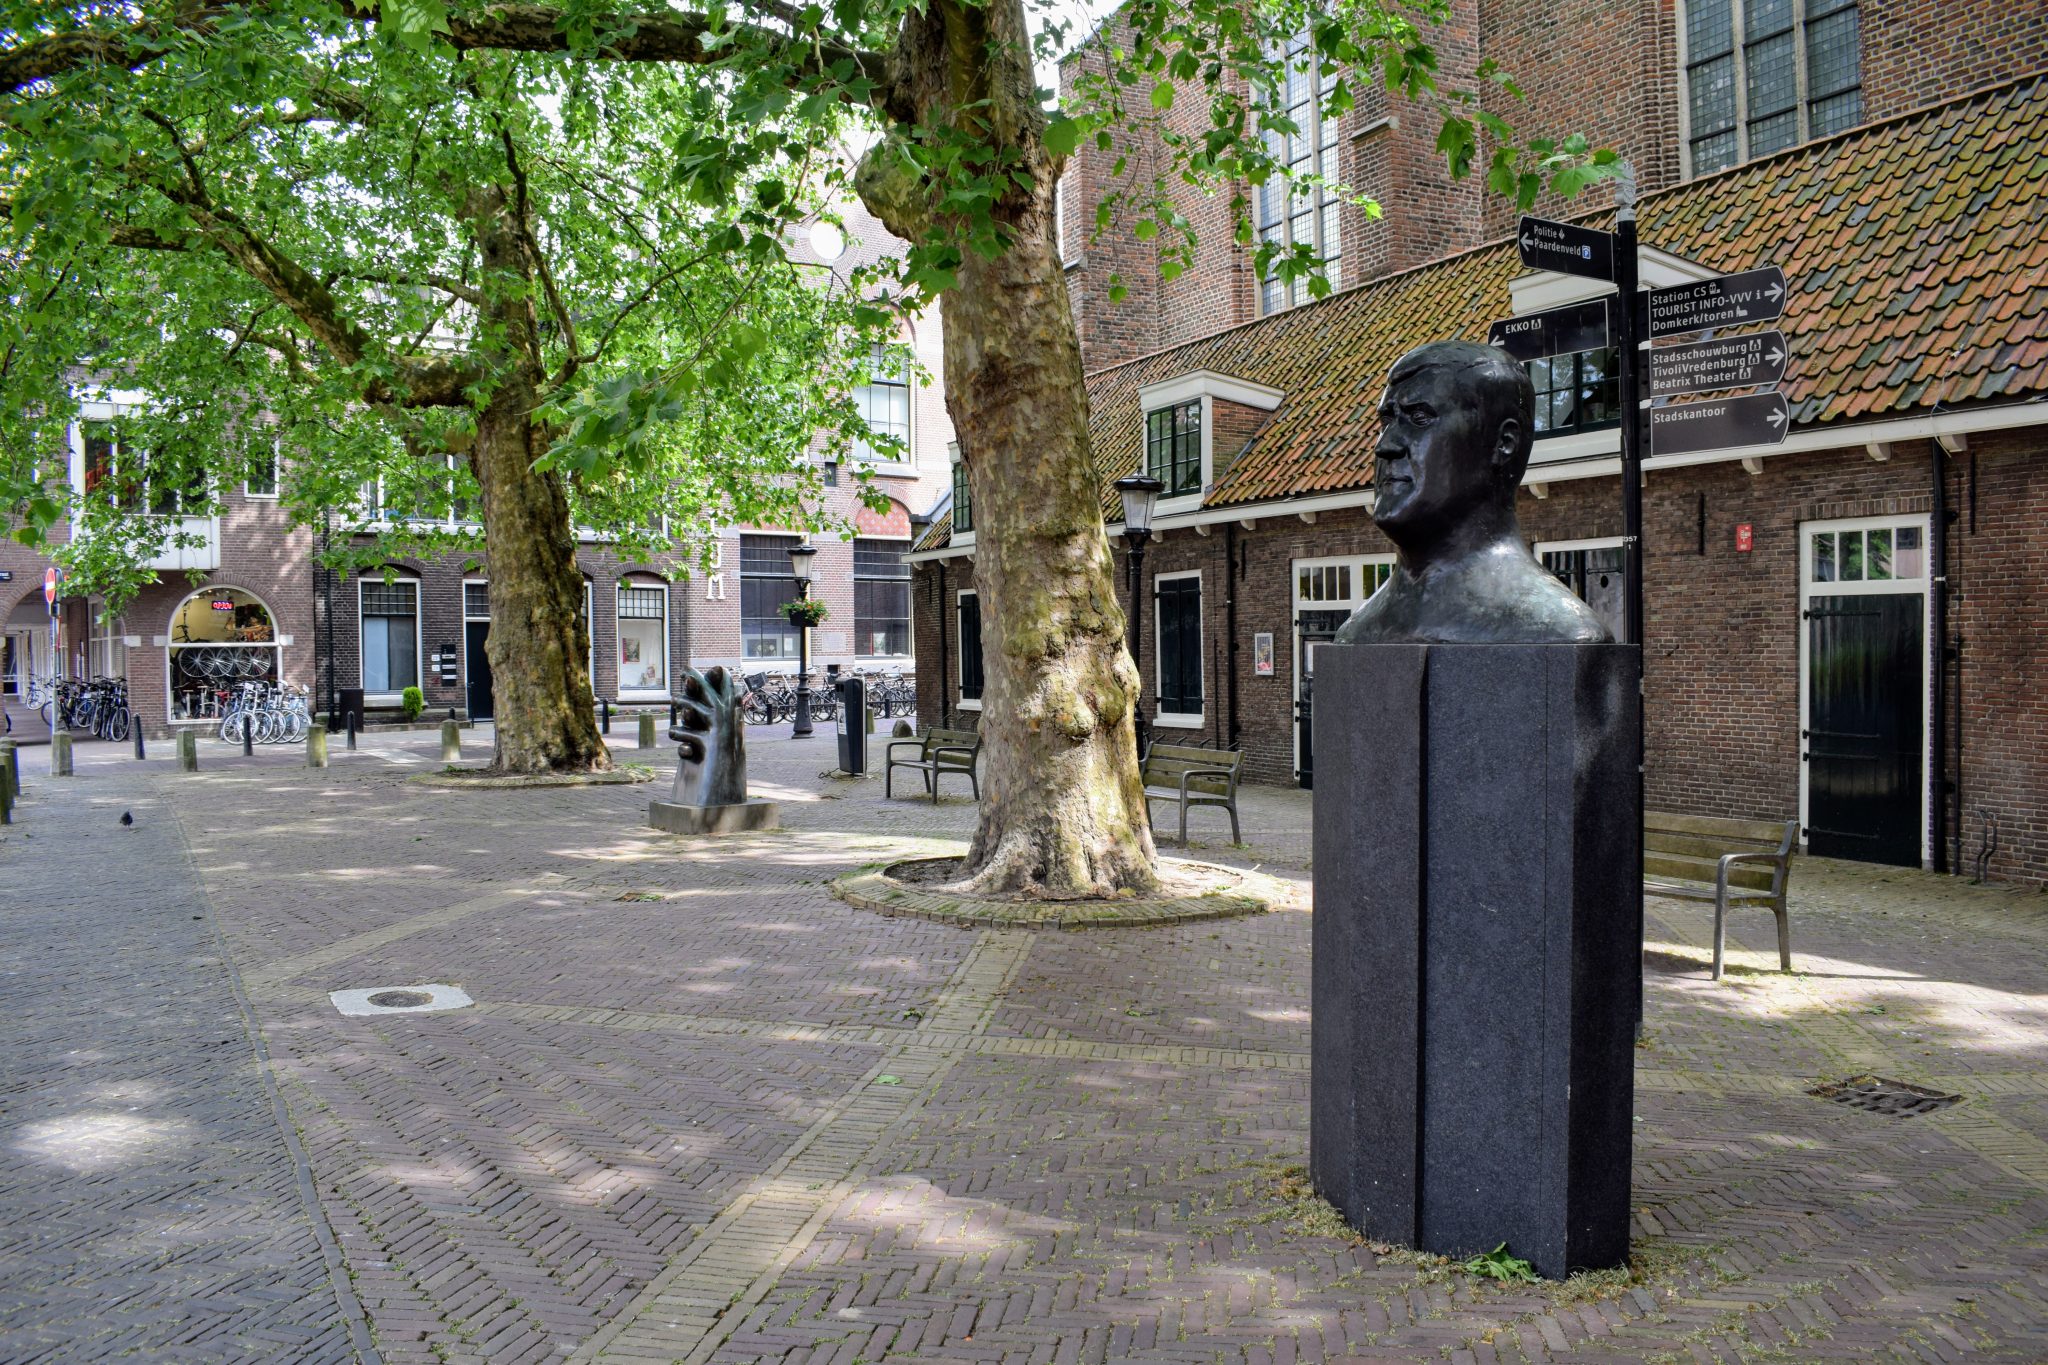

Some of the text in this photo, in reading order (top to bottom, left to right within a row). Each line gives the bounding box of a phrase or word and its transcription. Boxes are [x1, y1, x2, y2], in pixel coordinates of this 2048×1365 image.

[1533, 225, 1558, 239] Politie
[1534, 238, 1581, 256] Paardenveld
[1652, 286, 1707, 306] Station CS
[1652, 301, 1697, 318] TOURIST
[1699, 291, 1752, 310] INFO-VVV
[1505, 321, 1530, 334] EKKO
[1652, 310, 1734, 331] Domkerk/toren
[1652, 343, 1747, 365] Stadsschouwburg
[1652, 356, 1746, 377] TivoliVredenburg
[1653, 370, 1737, 390] Beatrix Theater
[1654, 406, 1727, 424] Stadskantoor
